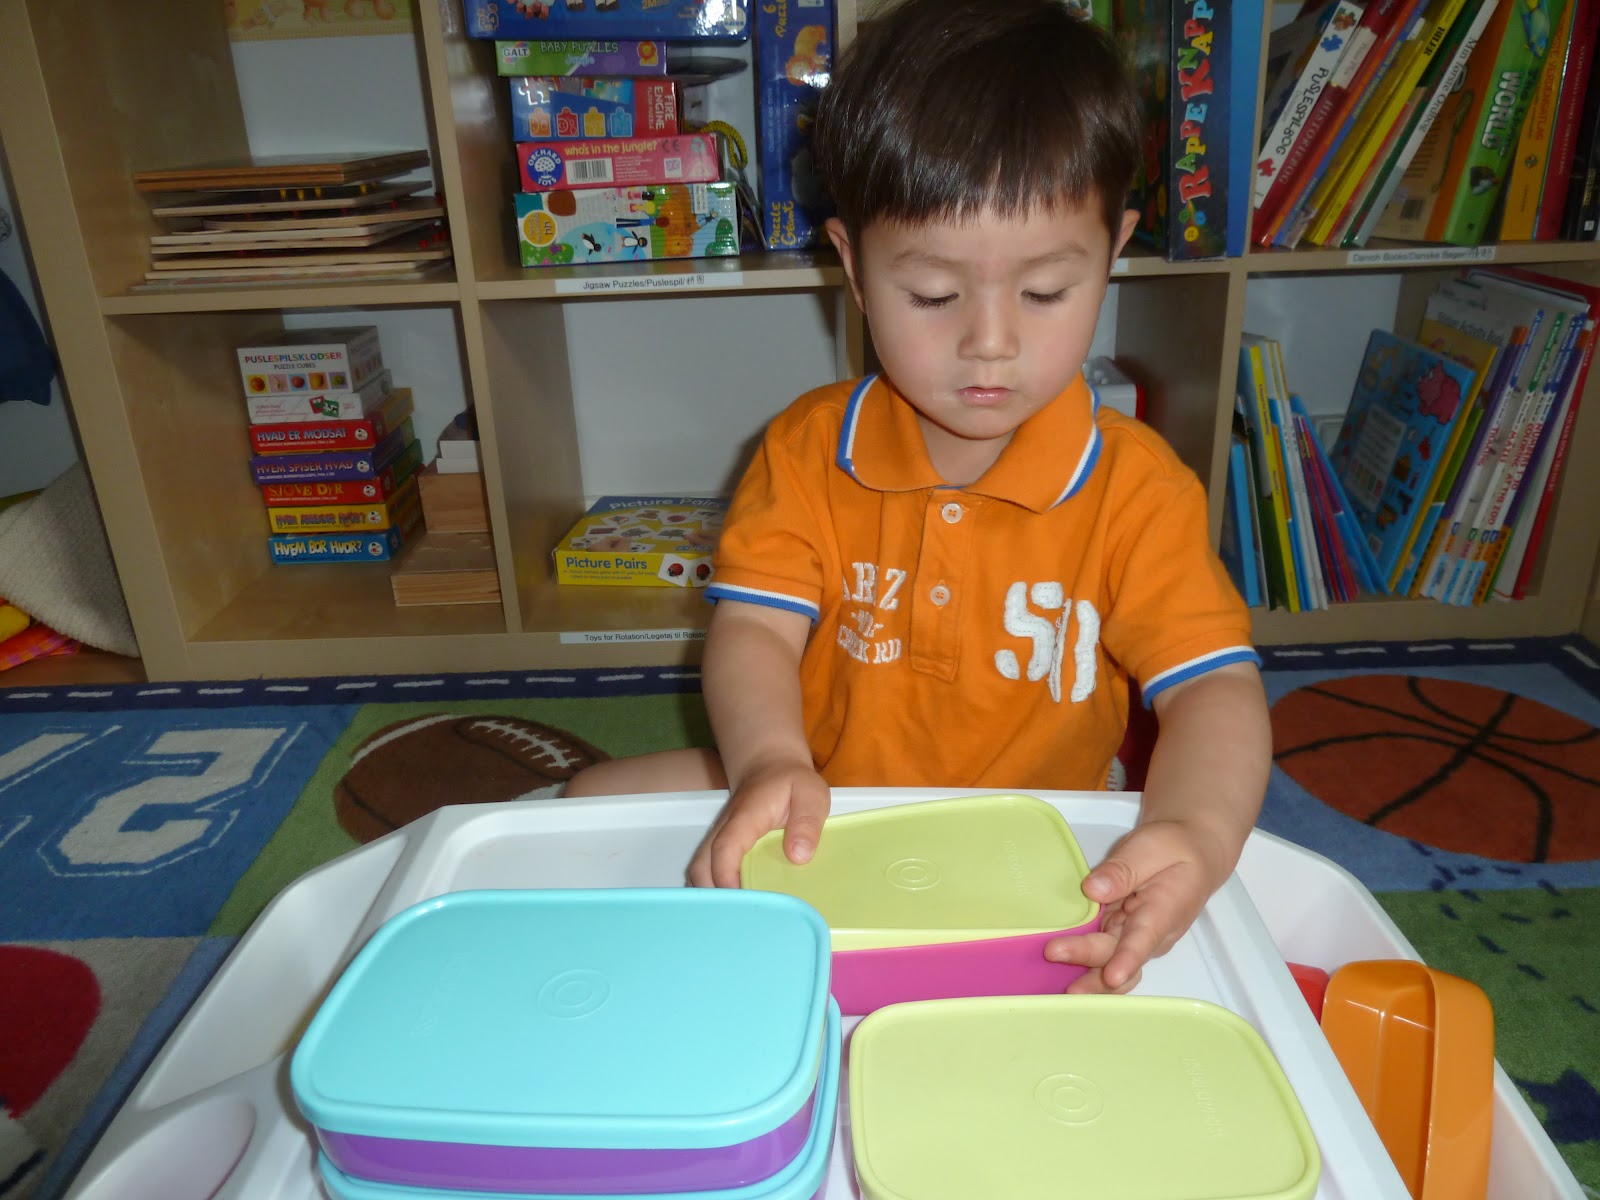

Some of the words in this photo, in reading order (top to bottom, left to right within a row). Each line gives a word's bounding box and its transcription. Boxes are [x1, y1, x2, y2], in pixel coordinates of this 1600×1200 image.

[774, 0, 788, 38] Puzz
[540, 41, 568, 53] BABY
[572, 41, 619, 53] PUZZLES
[1423, 26, 1445, 56] BILER
[1458, 36, 1477, 60] Min
[503, 48, 529, 57] GALT
[654, 86, 665, 131] ENGINE
[664, 95, 675, 121] FIRE
[1276, 66, 1330, 156] PUSLESPILBOG
[1417, 91, 1447, 134] Ordbog
[1481, 70, 1522, 150] WORLD
[564, 145, 590, 156] who's
[591, 144, 601, 154] in
[603, 143, 619, 153] the
[527, 149, 562, 166] ORCHARD
[537, 177, 557, 186] TOYS
[583, 281, 611, 290] Jigsaw
[244, 352, 343, 364] PUSLESPILSKLODSER
[256, 431, 286, 442] HVAD
[288, 430, 301, 441] ER
[303, 428, 347, 440] MODSAT
[256, 464, 286, 474] HVEM
[288, 462, 323, 473] SPISER
[325, 460, 354, 470] HVAD
[267, 484, 313, 497] SJOVE
[316, 483, 344, 495] DYR
[609, 498, 674, 510] Picture
[273, 542, 307, 557] HVEM
[308, 540, 328, 554] BOR
[330, 540, 363, 554] HVOR?
[565, 556, 612, 569] Picture
[615, 558, 648, 570] Pairs
[584, 634, 602, 643] Toys
